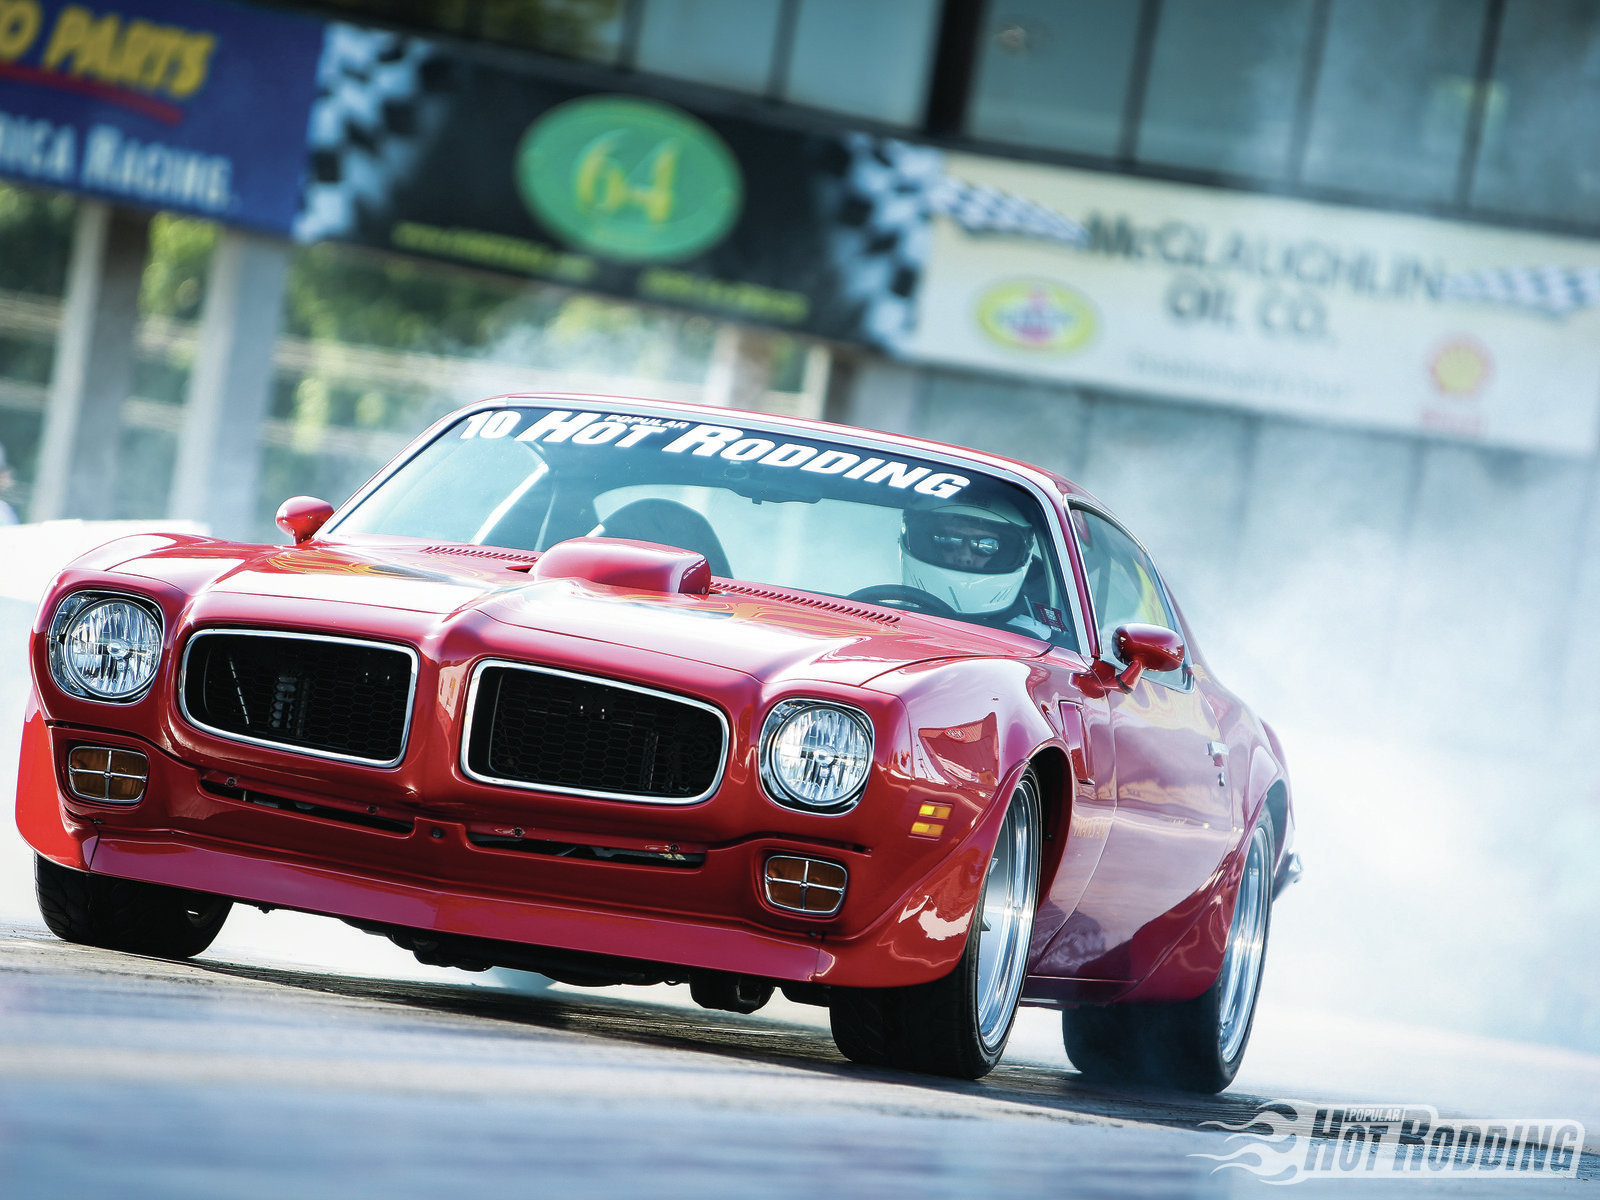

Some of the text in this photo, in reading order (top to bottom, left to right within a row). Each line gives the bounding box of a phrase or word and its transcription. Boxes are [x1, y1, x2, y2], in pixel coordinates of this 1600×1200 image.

[0, 0, 217, 98] O PARTS
[576, 128, 684, 227] 64
[1163, 272, 1236, 329] OIL
[459, 410, 971, 499] 10 HOT RODDING
[603, 414, 690, 430] POPULAR
